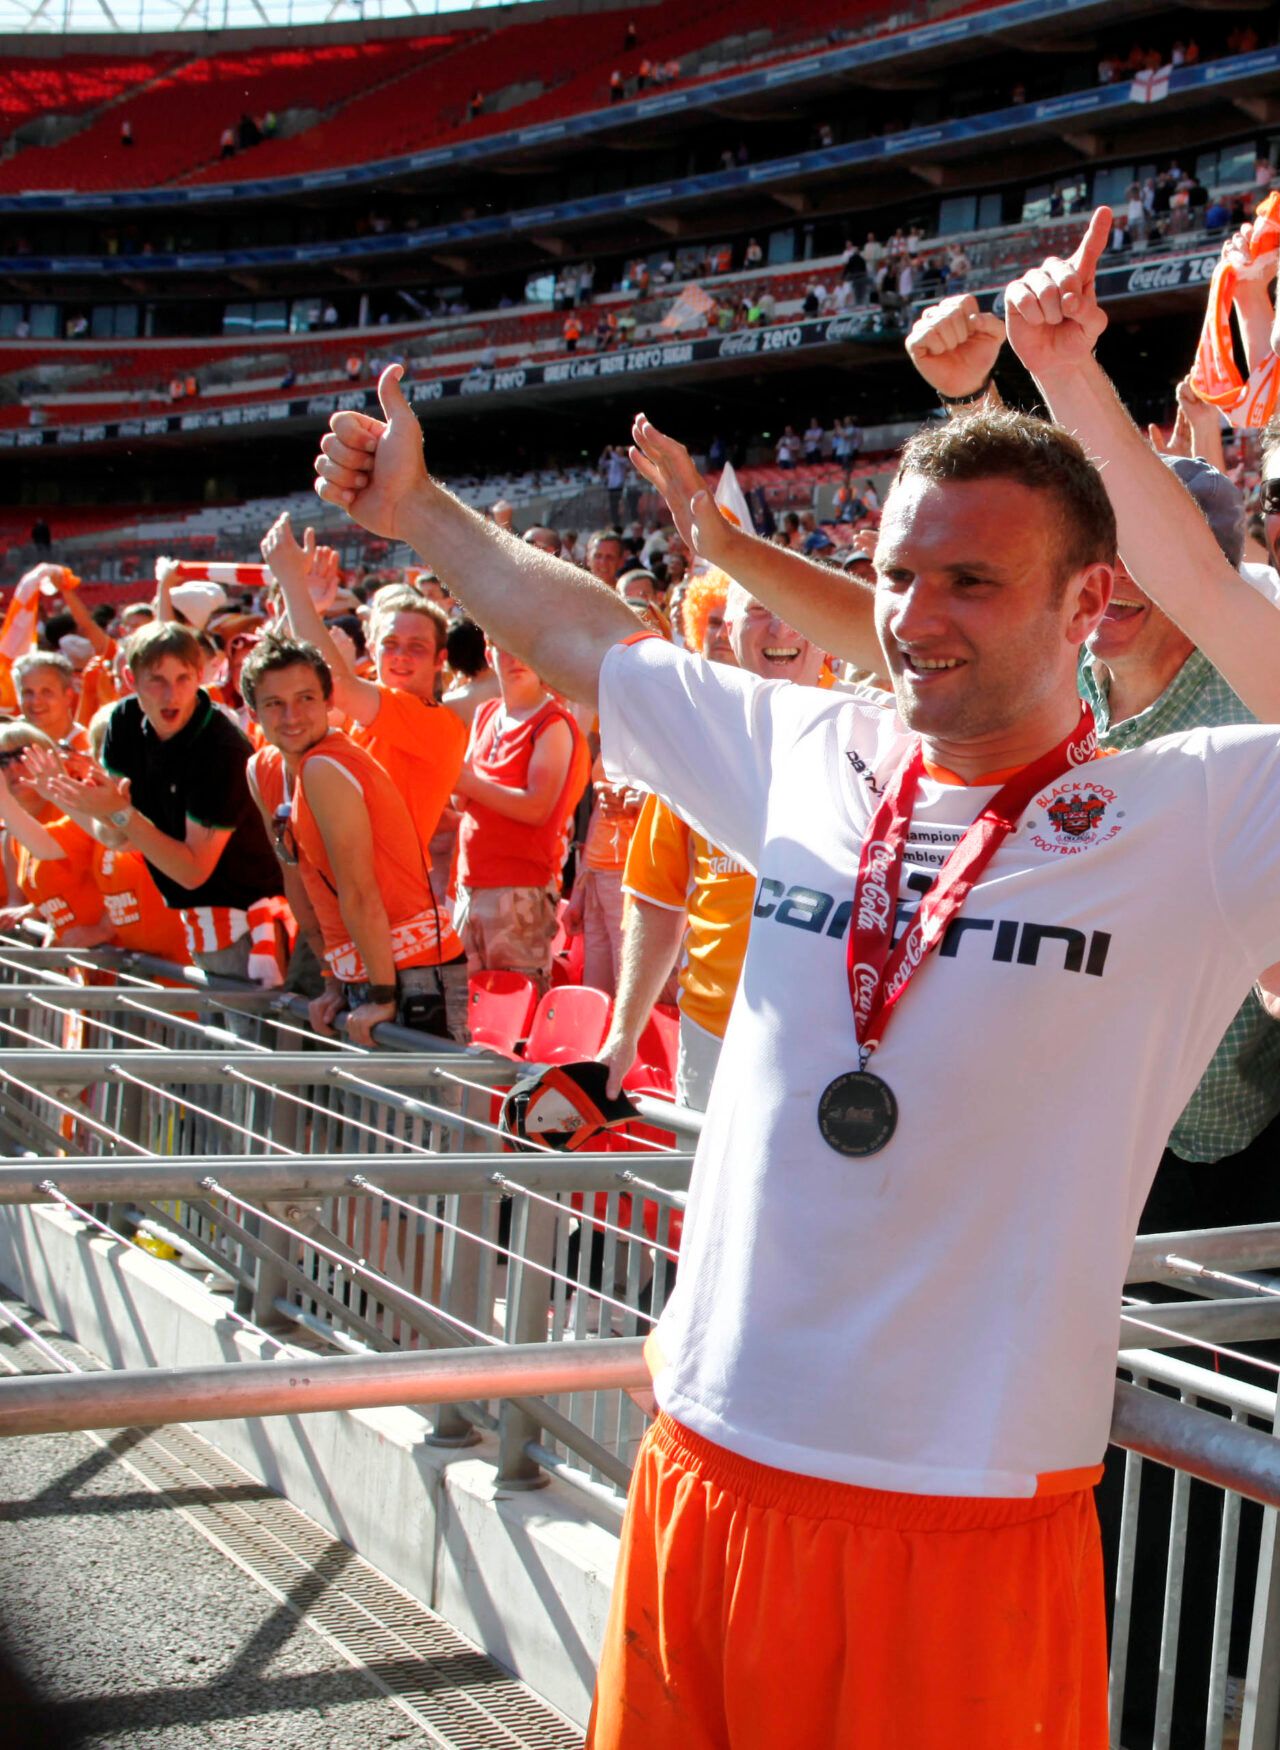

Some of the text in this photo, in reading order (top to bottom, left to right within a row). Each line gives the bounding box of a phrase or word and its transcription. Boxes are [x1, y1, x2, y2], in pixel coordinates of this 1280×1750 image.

[762, 327, 802, 350] zero
[627, 347, 661, 370] zero
[1035, 782, 1118, 810] BLACKPOOL
